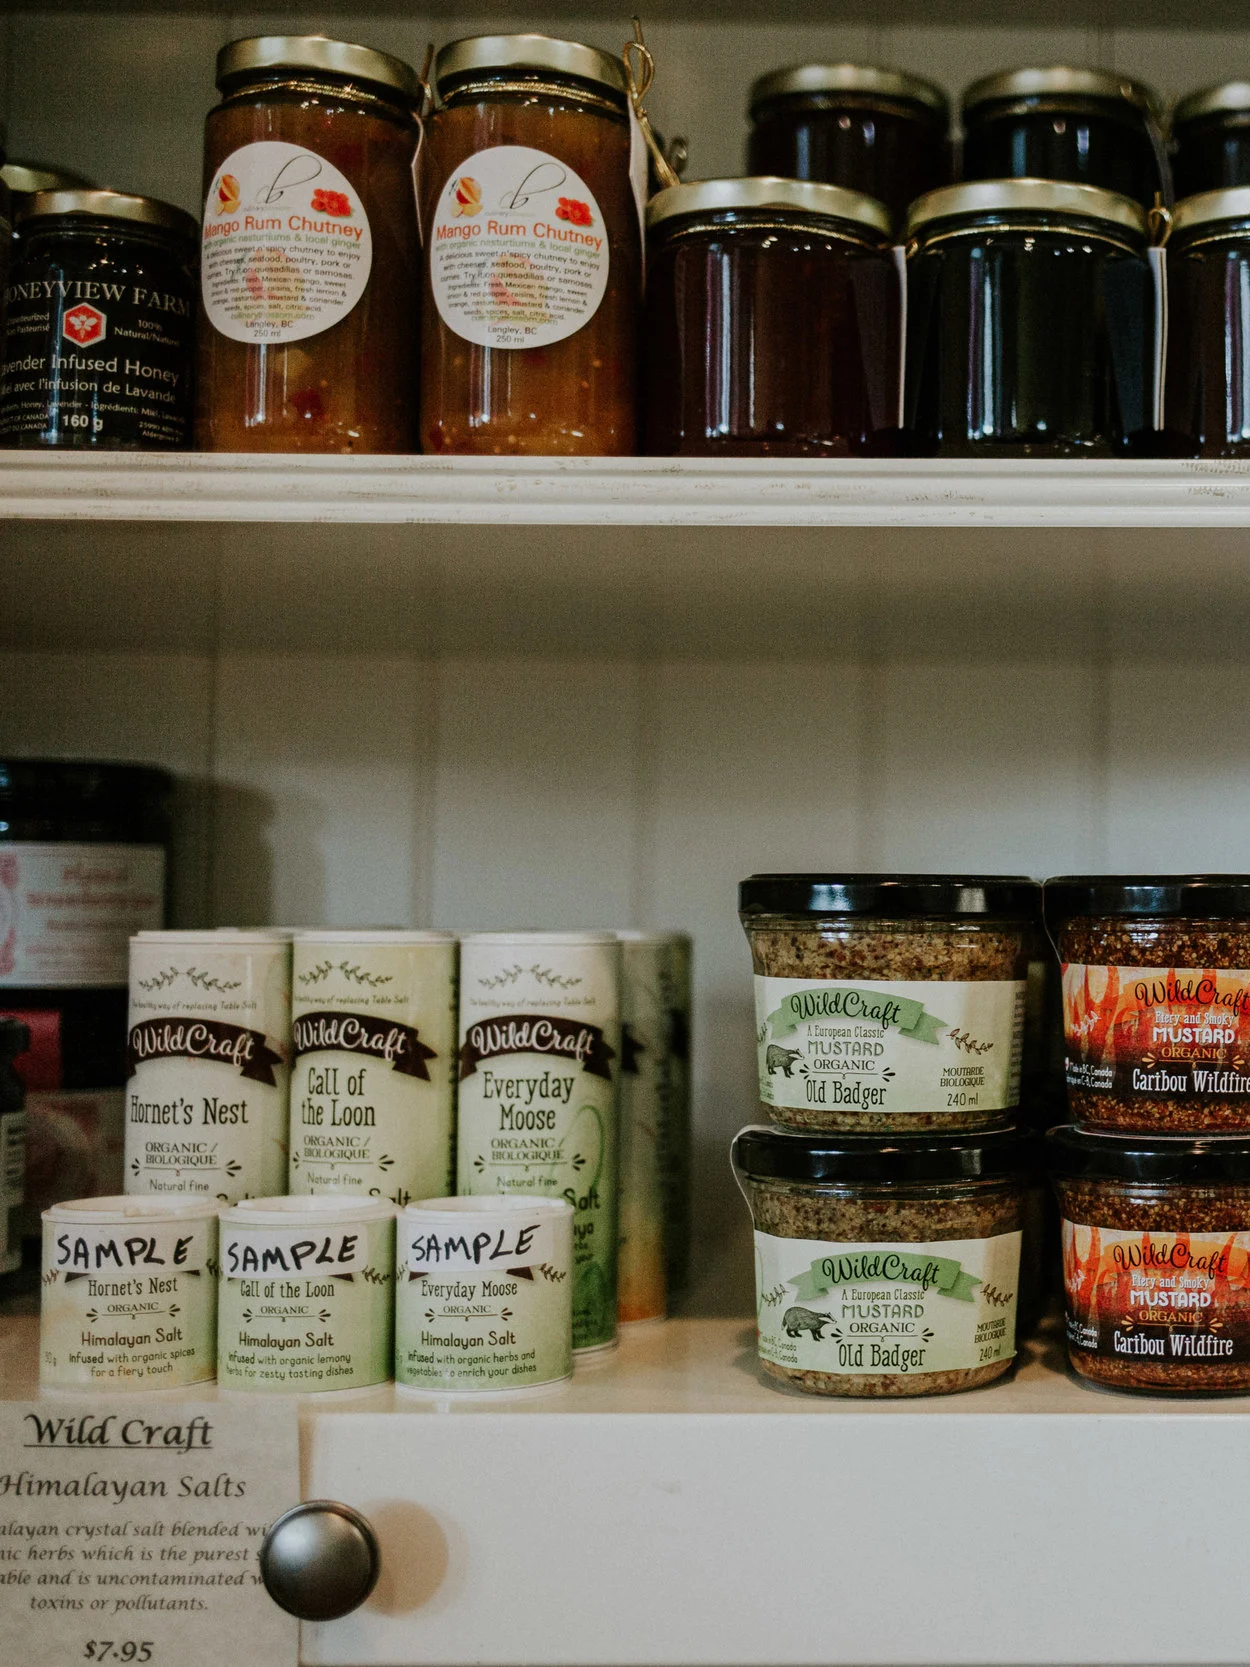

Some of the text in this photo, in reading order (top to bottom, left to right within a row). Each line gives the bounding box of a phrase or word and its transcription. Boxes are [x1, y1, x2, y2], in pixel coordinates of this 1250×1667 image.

[205, 216, 363, 241] Mango Rum Chutney
[437, 220, 602, 251] Mango Rum Chutney
[52, 354, 179, 387] Infused Honey
[103, 381, 120, 393] de
[63, 415, 89, 427] 160
[1135, 980, 1250, 1017] WildCraft
[791, 992, 901, 1029] WildCraft
[133, 1024, 254, 1067] WildCraft
[294, 1019, 406, 1060] WildCraft
[471, 1021, 593, 1062] WildCraft
[1152, 1027, 1235, 1043] MUSTARD
[808, 1041, 883, 1057] MUSTARD
[814, 1060, 875, 1071] ORGANIC
[943, 1067, 984, 1077] MOUTARDE
[308, 1068, 366, 1096] Call of
[483, 1071, 575, 1105] Everyday
[940, 1077, 984, 1087] BIOLOGIQUE
[1133, 1068, 1187, 1092] Caribou
[807, 1080, 886, 1110] Old Badger
[947, 1093, 978, 1106] 240 ml
[130, 1096, 249, 1124] Hornet's Nest
[302, 1100, 376, 1126] the Loon
[500, 1104, 556, 1130] Moose
[57, 1235, 193, 1269] SAMPLE
[228, 1235, 358, 1274] SAMPLE
[412, 1225, 541, 1264] SAMPLE
[822, 1255, 939, 1291] WildCraft
[1113, 1243, 1226, 1280] WildCraft
[88, 1278, 178, 1297] Hornet's Nest
[241, 1280, 335, 1298] Call of the Loon
[422, 1281, 517, 1301] Everyday Moose
[1130, 1290, 1211, 1307] MUSTARD
[842, 1304, 924, 1318] MUSTARD
[1139, 1310, 1203, 1322] ORGANIC
[81, 1328, 182, 1347] Himalayan Salt
[850, 1322, 915, 1332] ORGANIC
[239, 1332, 334, 1351] Himalayan Salt
[422, 1331, 516, 1349] Himalayan Salt
[1114, 1333, 1164, 1355] Caribou
[1170, 1334, 1233, 1356] Wildfire
[838, 1344, 926, 1372] Old Badger
[24, 1414, 214, 1454] Wild Craft
[0, 1472, 246, 1504] Himalayan Salts
[66, 1521, 129, 1540] crystal
[134, 1521, 164, 1536] salt
[172, 1521, 239, 1536] blended
[28, 1545, 75, 1561] herbs
[81, 1546, 134, 1561] which
[140, 1548, 154, 1561] is
[161, 1545, 187, 1561] the
[192, 1548, 248, 1565] purest
[37, 1572, 71, 1586] and
[78, 1572, 90, 1586] is
[97, 1572, 244, 1586] uncontaminated
[30, 1595, 208, 1614] toxins or pollutants.
[84, 1640, 154, 1662] $7.95
